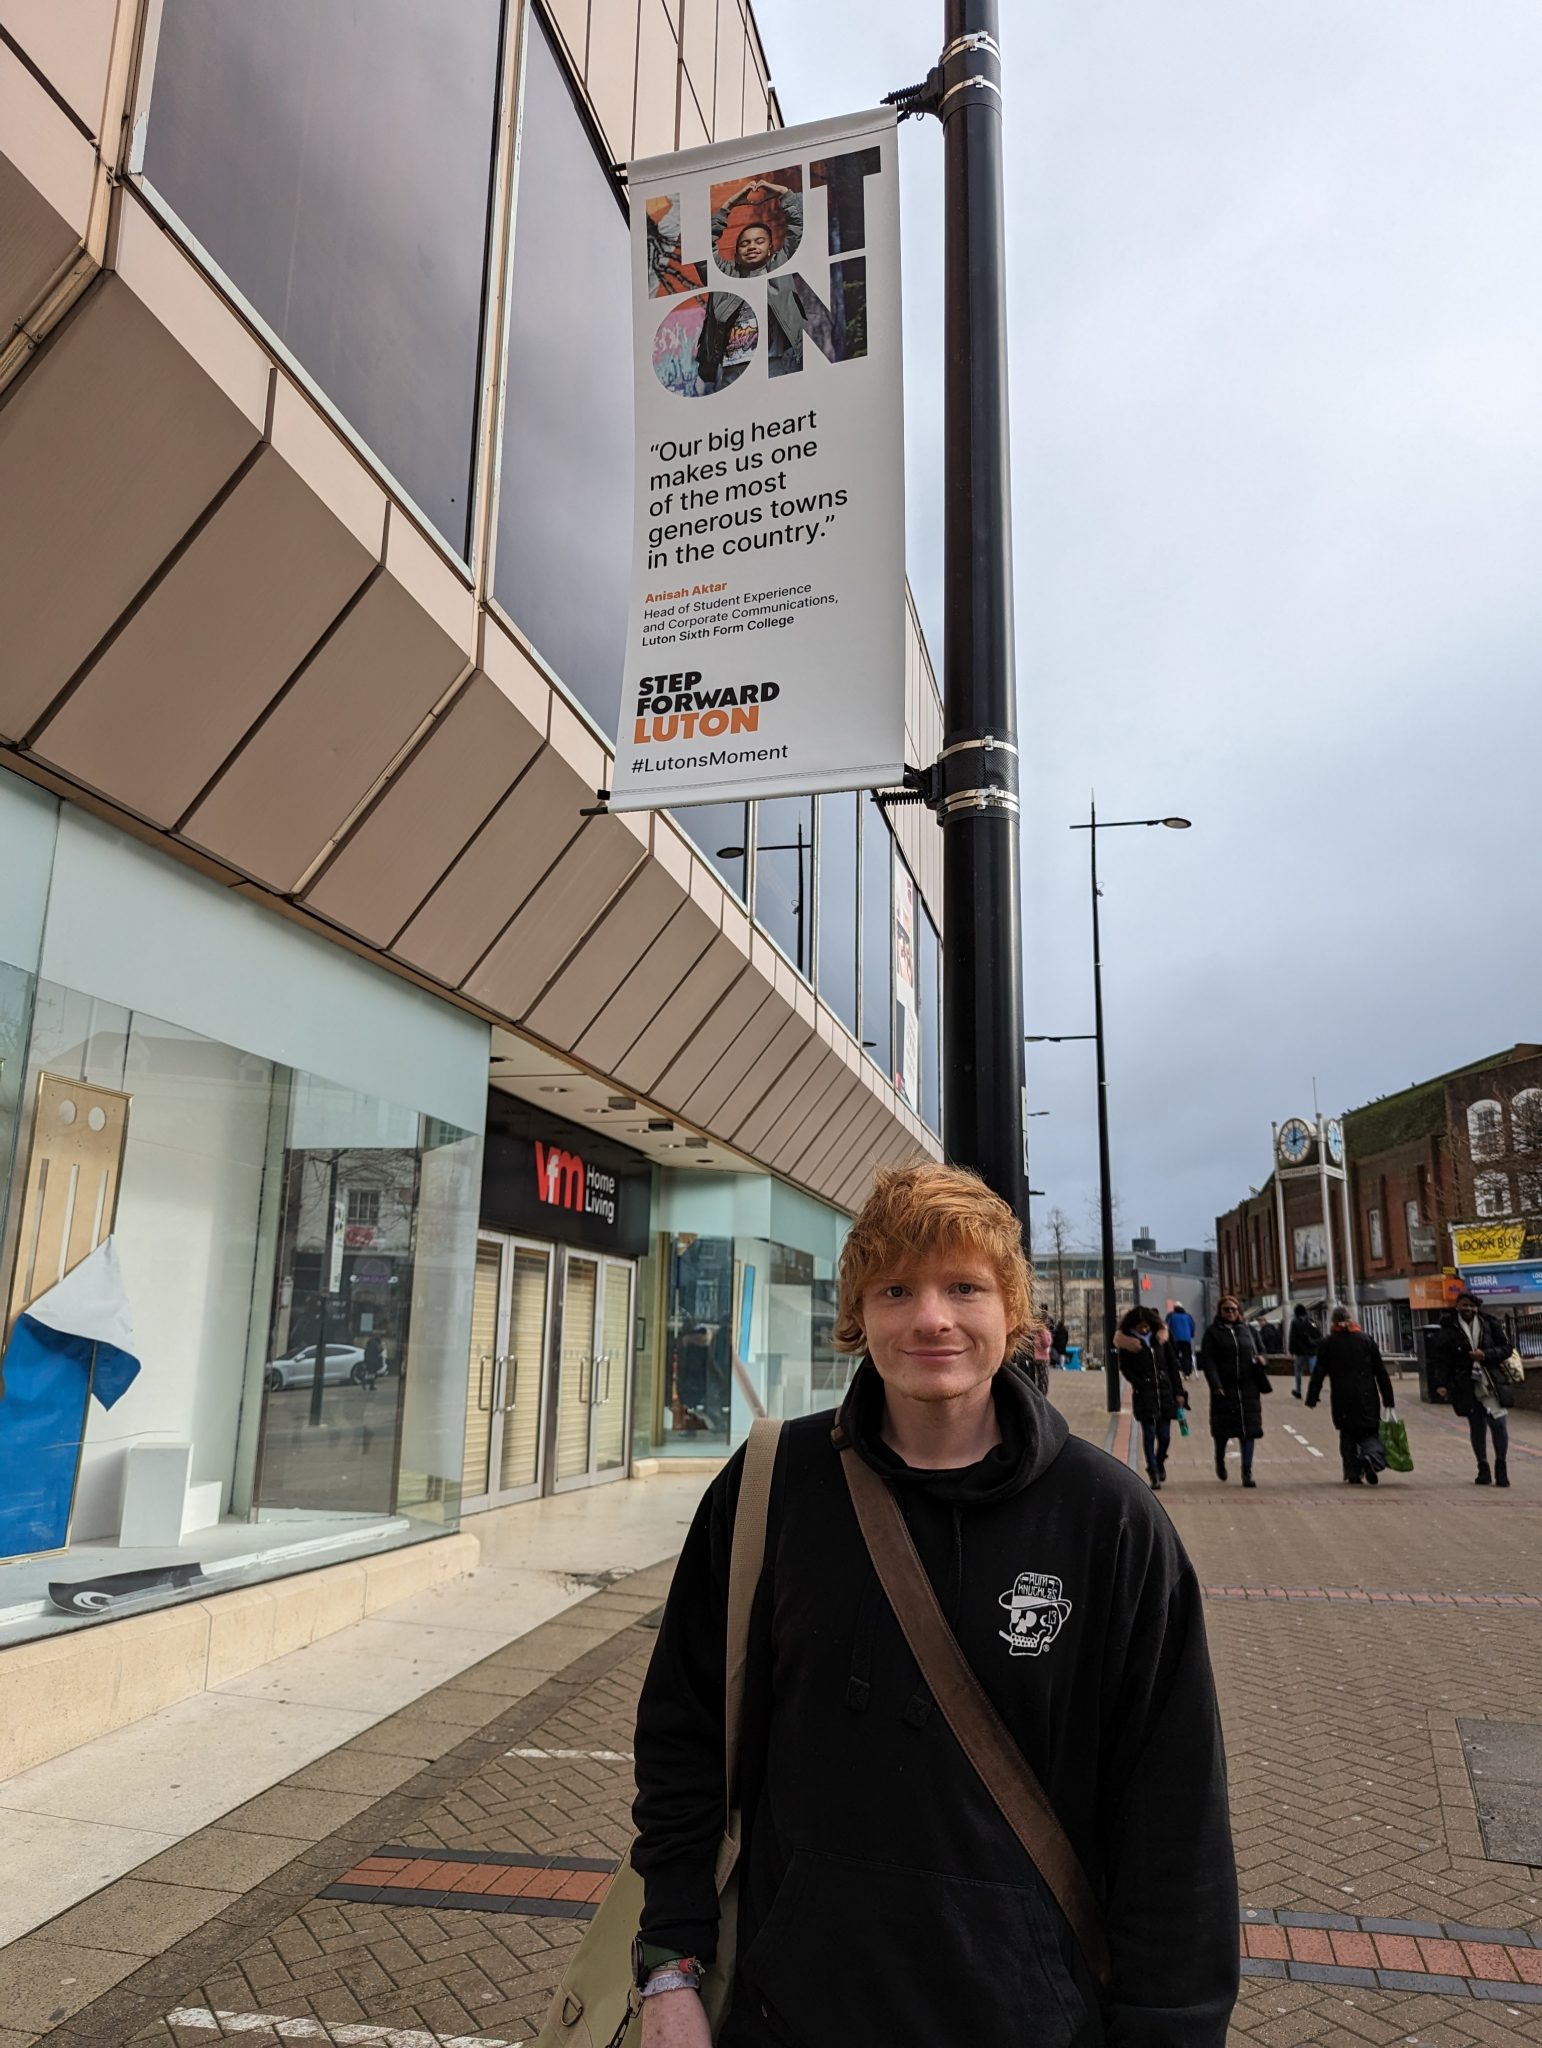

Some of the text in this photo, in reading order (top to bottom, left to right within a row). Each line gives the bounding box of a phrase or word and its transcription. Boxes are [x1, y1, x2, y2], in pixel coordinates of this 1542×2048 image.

[650, 410, 817, 462] “Our big heart
[650, 440, 818, 491] makes us one
[649, 471, 787, 517] of the most
[648, 488, 848, 548] generous towns
[648, 514, 835, 569] in the country.”
[644, 583, 812, 620] Head of Student Experience
[645, 582, 728, 603] Anisah Aktar
[642, 593, 839, 633] and Corporate Communications,
[642, 614, 795, 647] Luton Sixth Form College
[636, 681, 780, 717] FORWARD
[638, 671, 702, 696] STEP
[633, 705, 759, 744] LUTON
[631, 744, 789, 773] #LutonsMoment
[586, 1164, 615, 1194] Home
[585, 1189, 615, 1224] Living
[1469, 1275, 1498, 1287] LEBARA
[1017, 1583, 1058, 1600] KNUCKLES
[1048, 1610, 1057, 1624] 13
